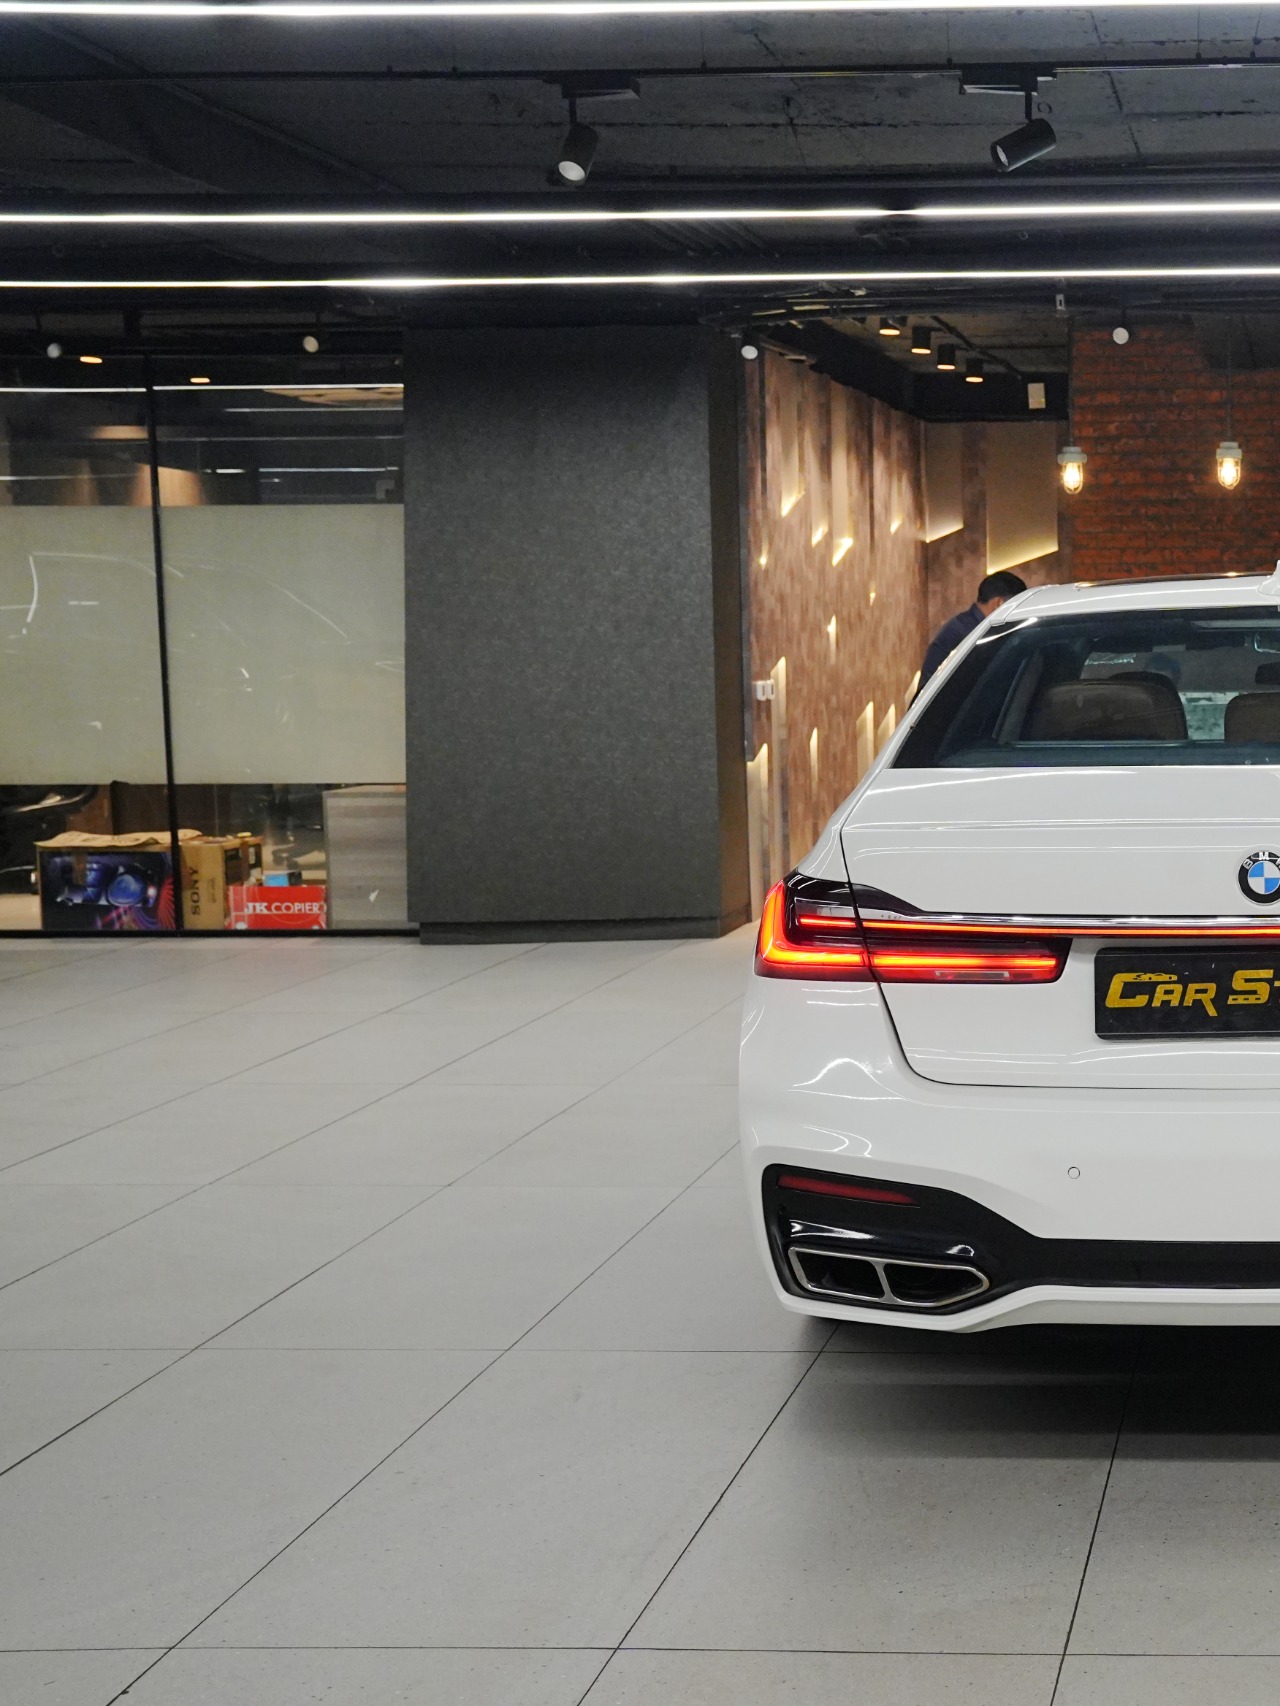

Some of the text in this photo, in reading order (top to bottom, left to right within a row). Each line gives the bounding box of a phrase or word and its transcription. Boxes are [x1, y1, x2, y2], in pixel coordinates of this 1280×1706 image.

[190, 866, 200, 916] SONY
[244, 902, 320, 914] JK COPIER
[1105, 972, 1218, 1017] CAR
